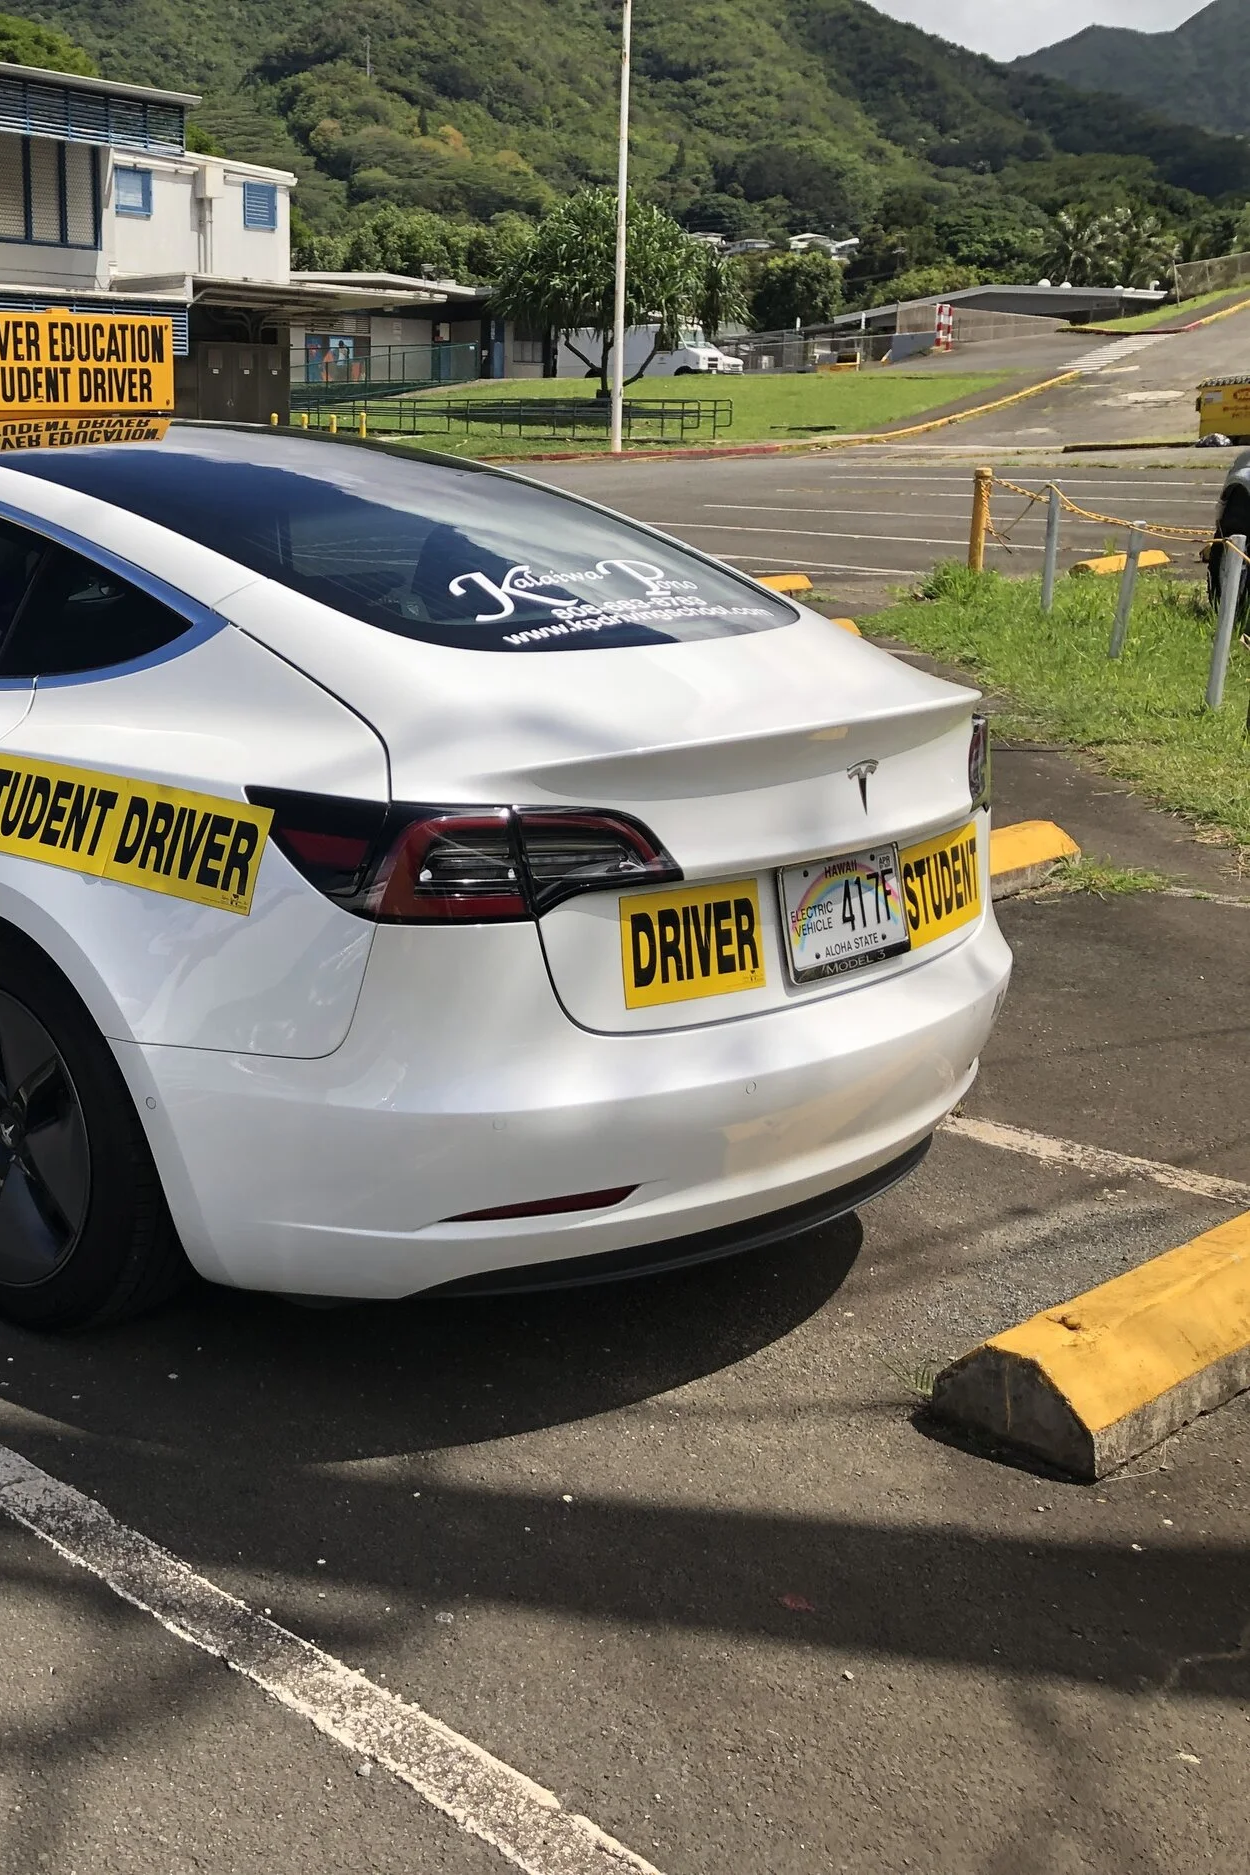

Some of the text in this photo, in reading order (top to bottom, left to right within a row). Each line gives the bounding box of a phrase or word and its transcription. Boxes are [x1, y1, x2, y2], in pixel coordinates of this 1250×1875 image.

[48, 321, 165, 363] EDUCATION
[78, 367, 153, 403] DRIVER
[502, 604, 775, 646] www.kpdrivingschool.com
[113, 796, 259, 896] DRIVER
[824, 860, 858, 879] HAWAII
[903, 837, 978, 930] STUDENT
[790, 901, 834, 923] ELECTRIC
[842, 867, 893, 932] 417F
[631, 897, 759, 989] DRIVER
[795, 917, 833, 938] VEHICLE
[825, 932, 879, 958] ALOHA STATE
[824, 949, 886, 975] MODEL 3
